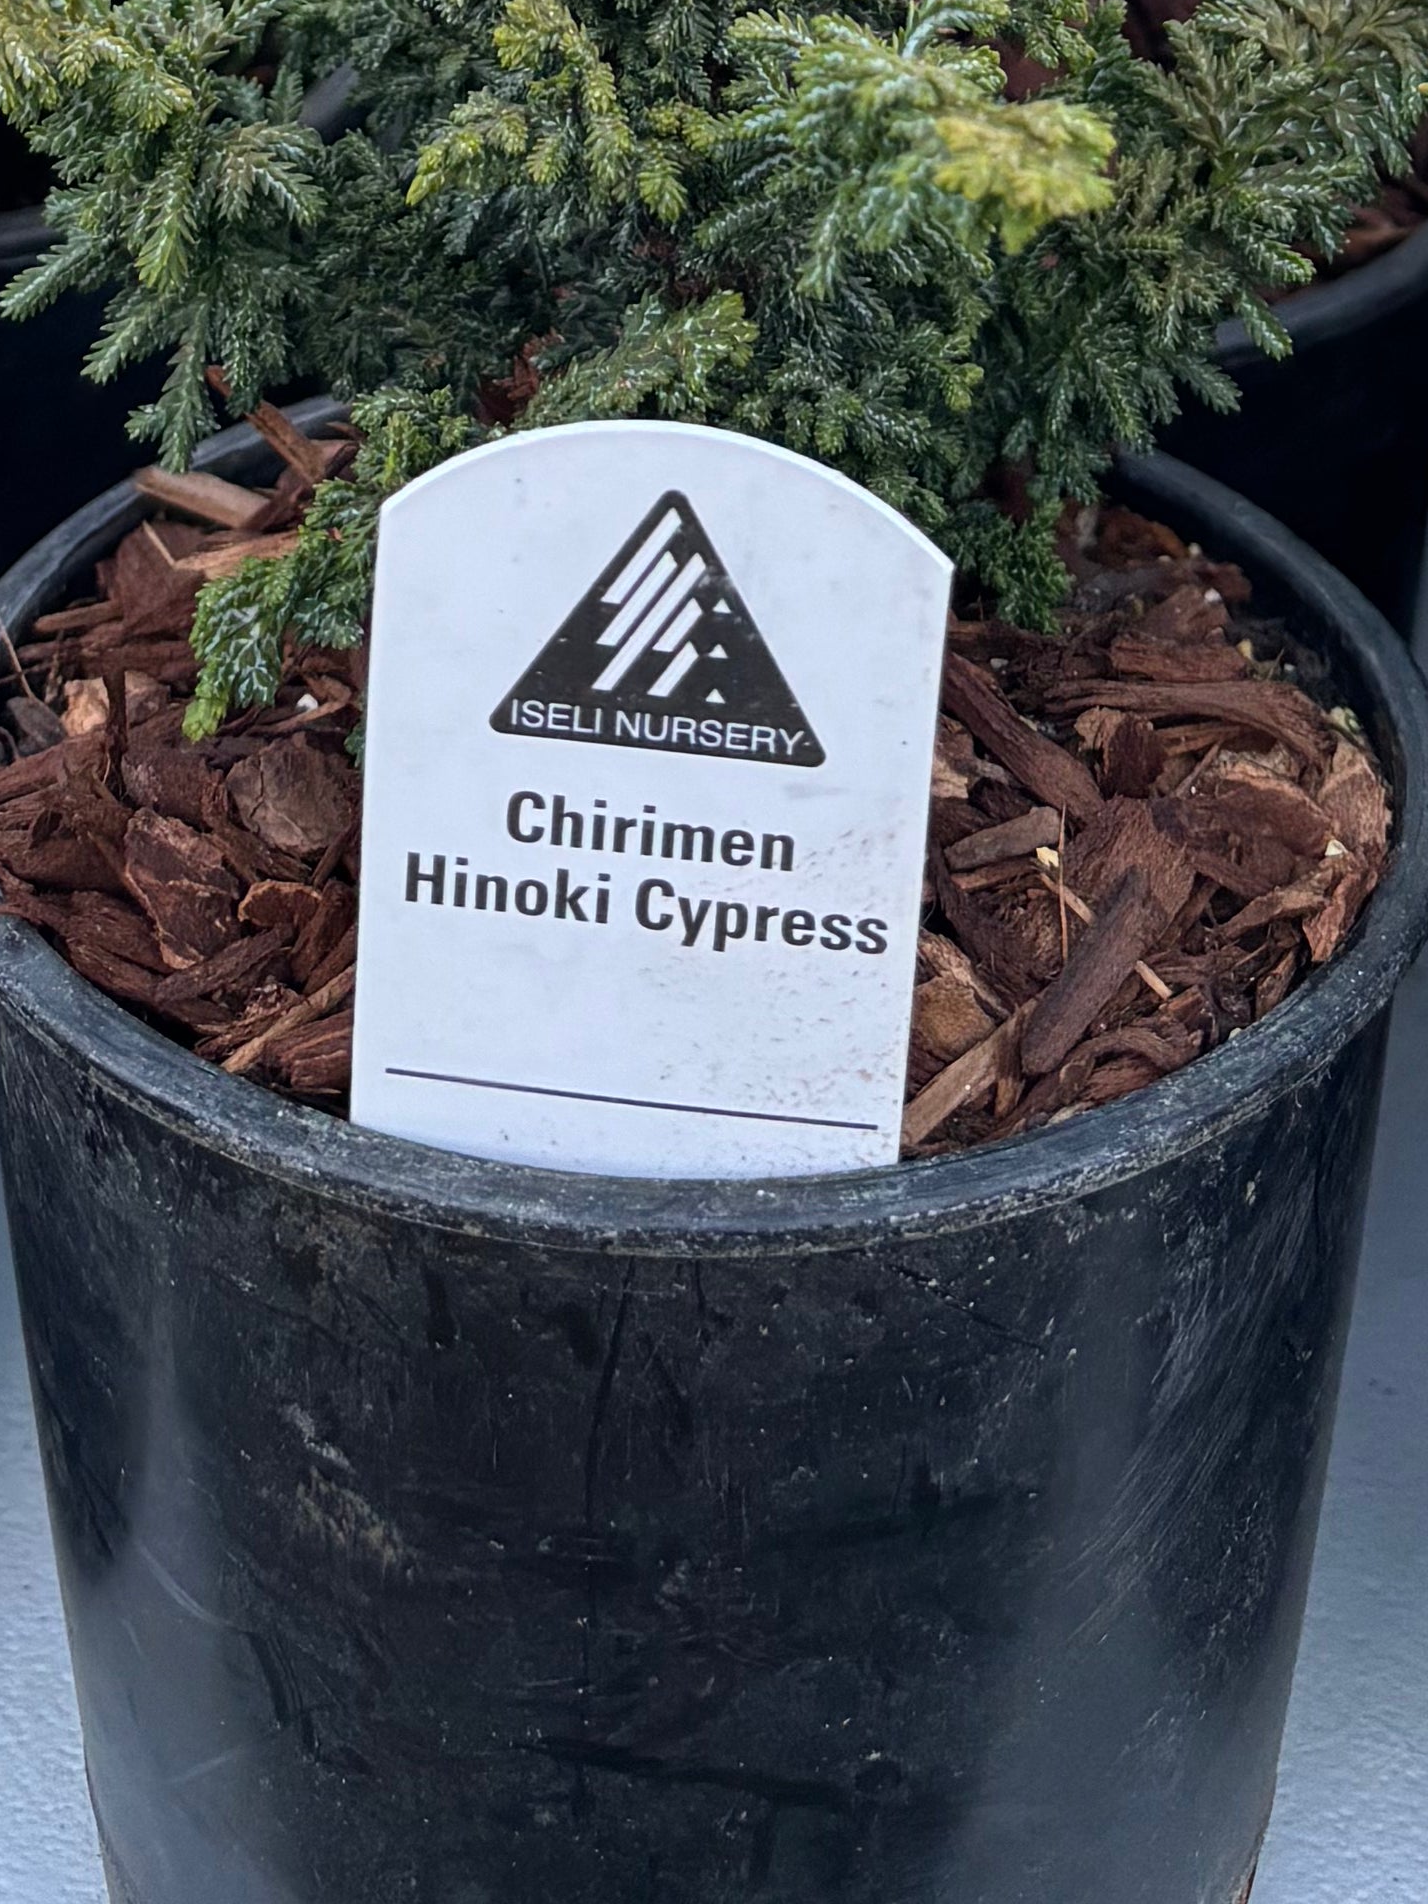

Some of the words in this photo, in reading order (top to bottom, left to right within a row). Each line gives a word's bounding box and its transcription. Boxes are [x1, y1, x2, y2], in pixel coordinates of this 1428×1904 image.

[510, 698, 602, 735] ISELI
[614, 709, 806, 757] NURSERY
[505, 789, 797, 872] Chirimen
[404, 851, 613, 924] Hinoki
[634, 877, 890, 956] Cypress
